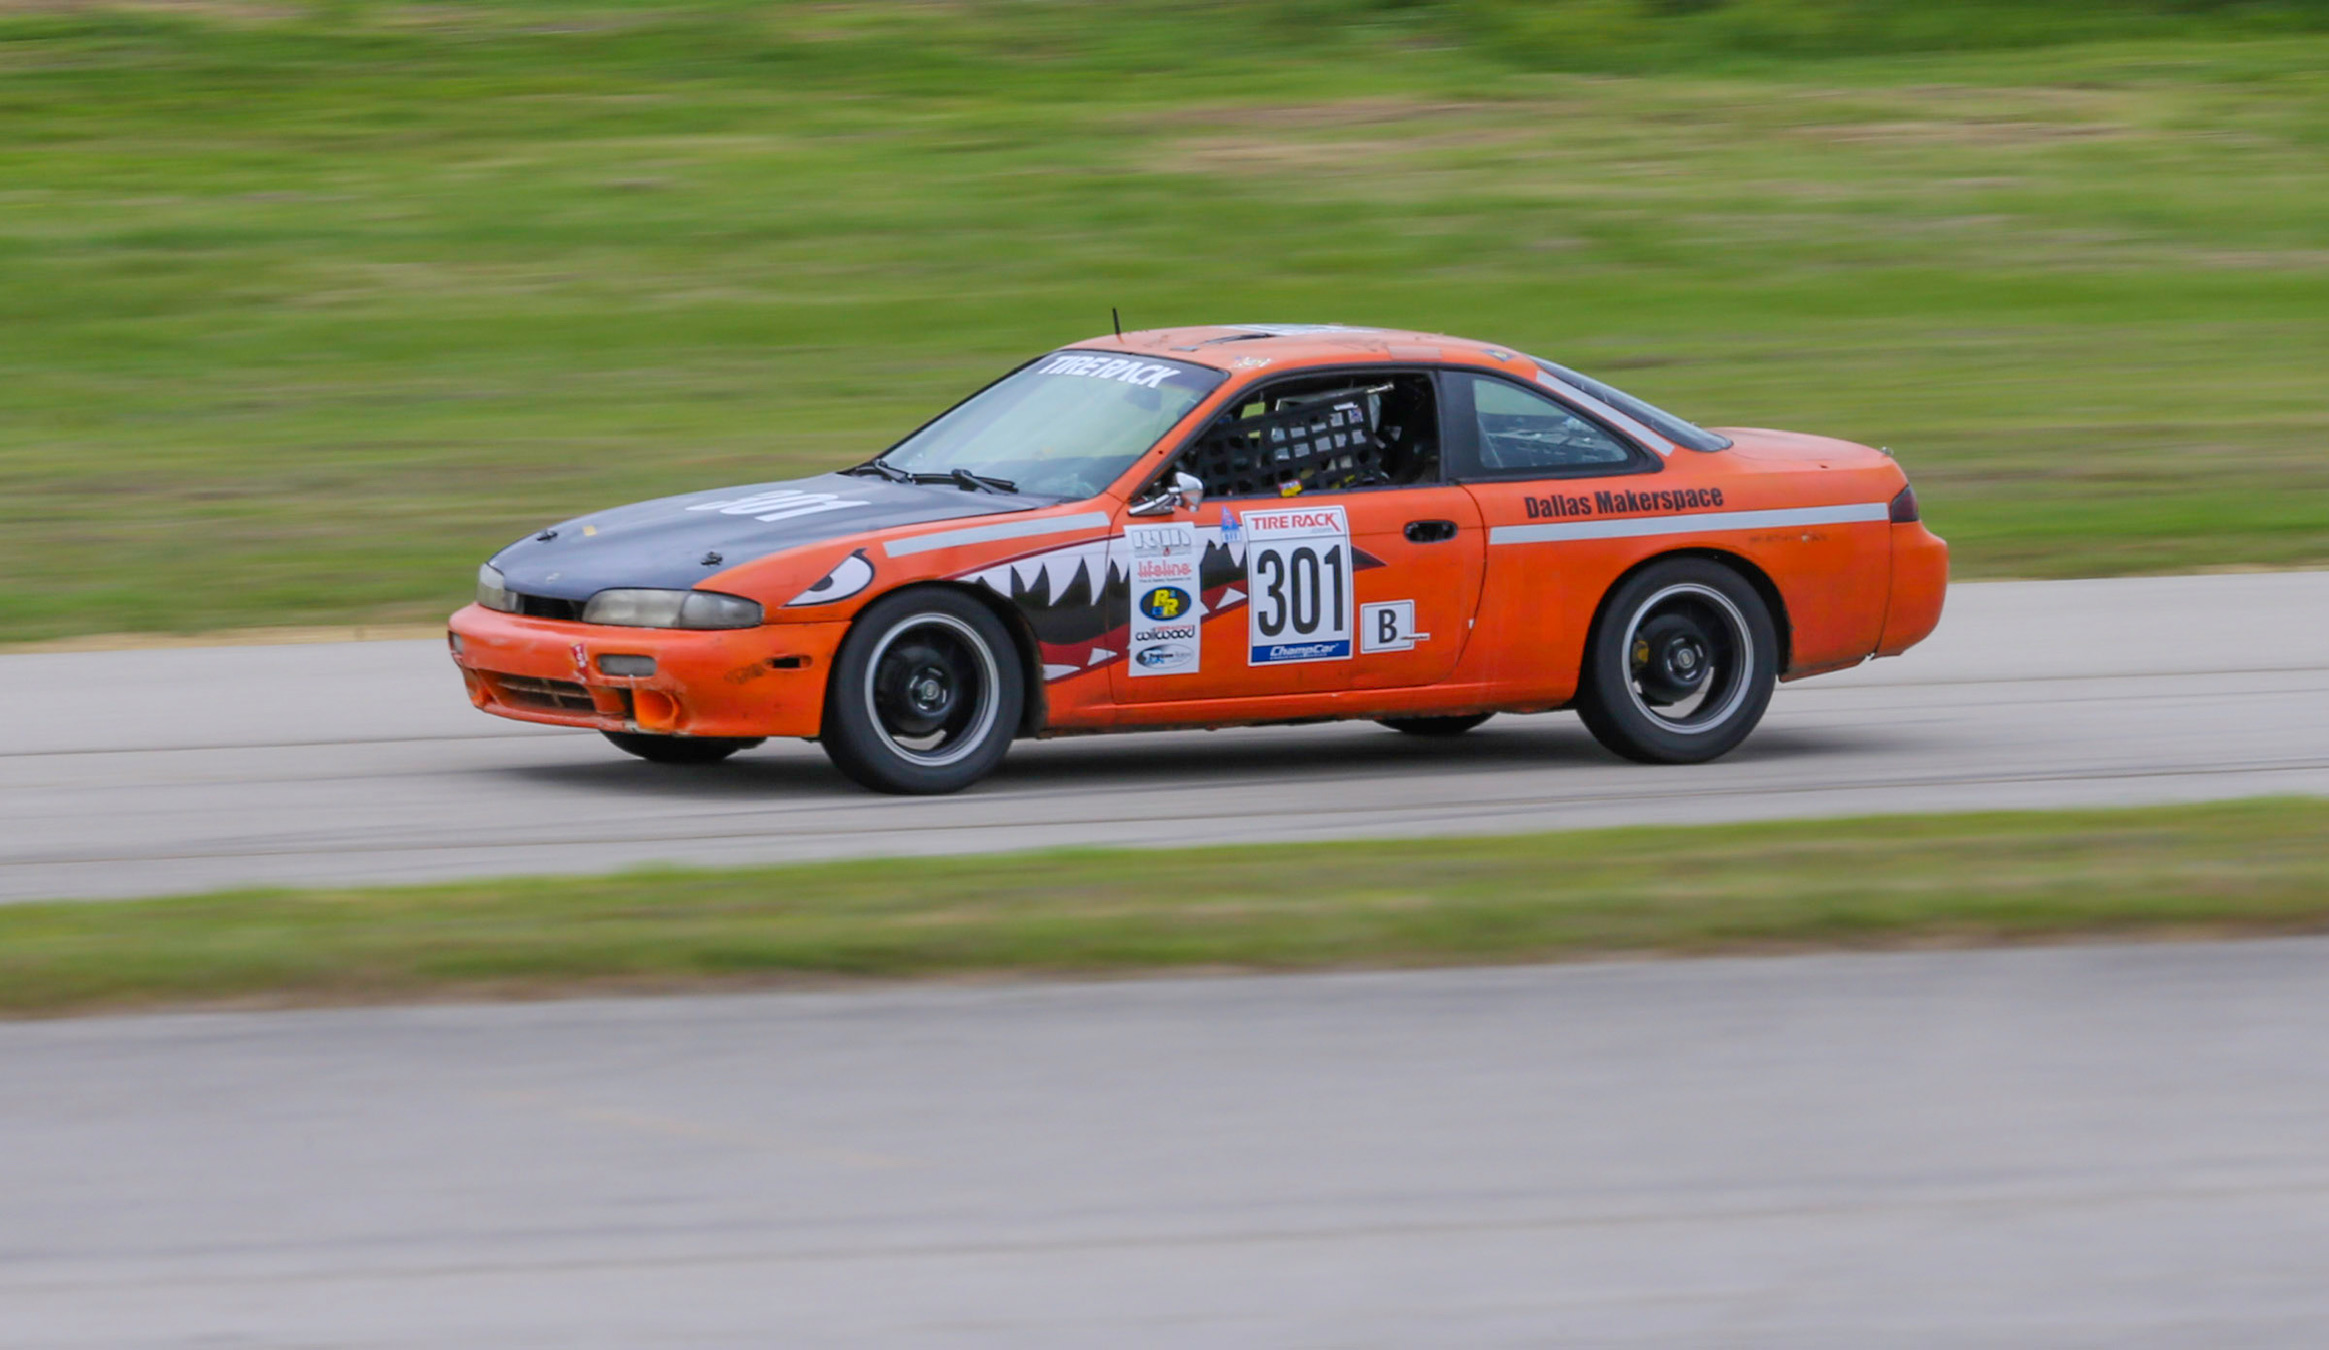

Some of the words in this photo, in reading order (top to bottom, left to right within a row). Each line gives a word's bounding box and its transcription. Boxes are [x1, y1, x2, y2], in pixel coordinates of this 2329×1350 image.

[1038, 355, 1112, 377] TIRE
[1088, 359, 1181, 389] RACK
[685, 489, 872, 523] 301
[1524, 496, 1592, 519] Dallas
[1594, 487, 1724, 515] Makerspace
[1251, 515, 1289, 531] TIRE
[1291, 512, 1342, 533] RACK
[1256, 543, 1344, 637] 301
[1378, 608, 1397, 644] B
[1269, 643, 1336, 658] ChampCar
